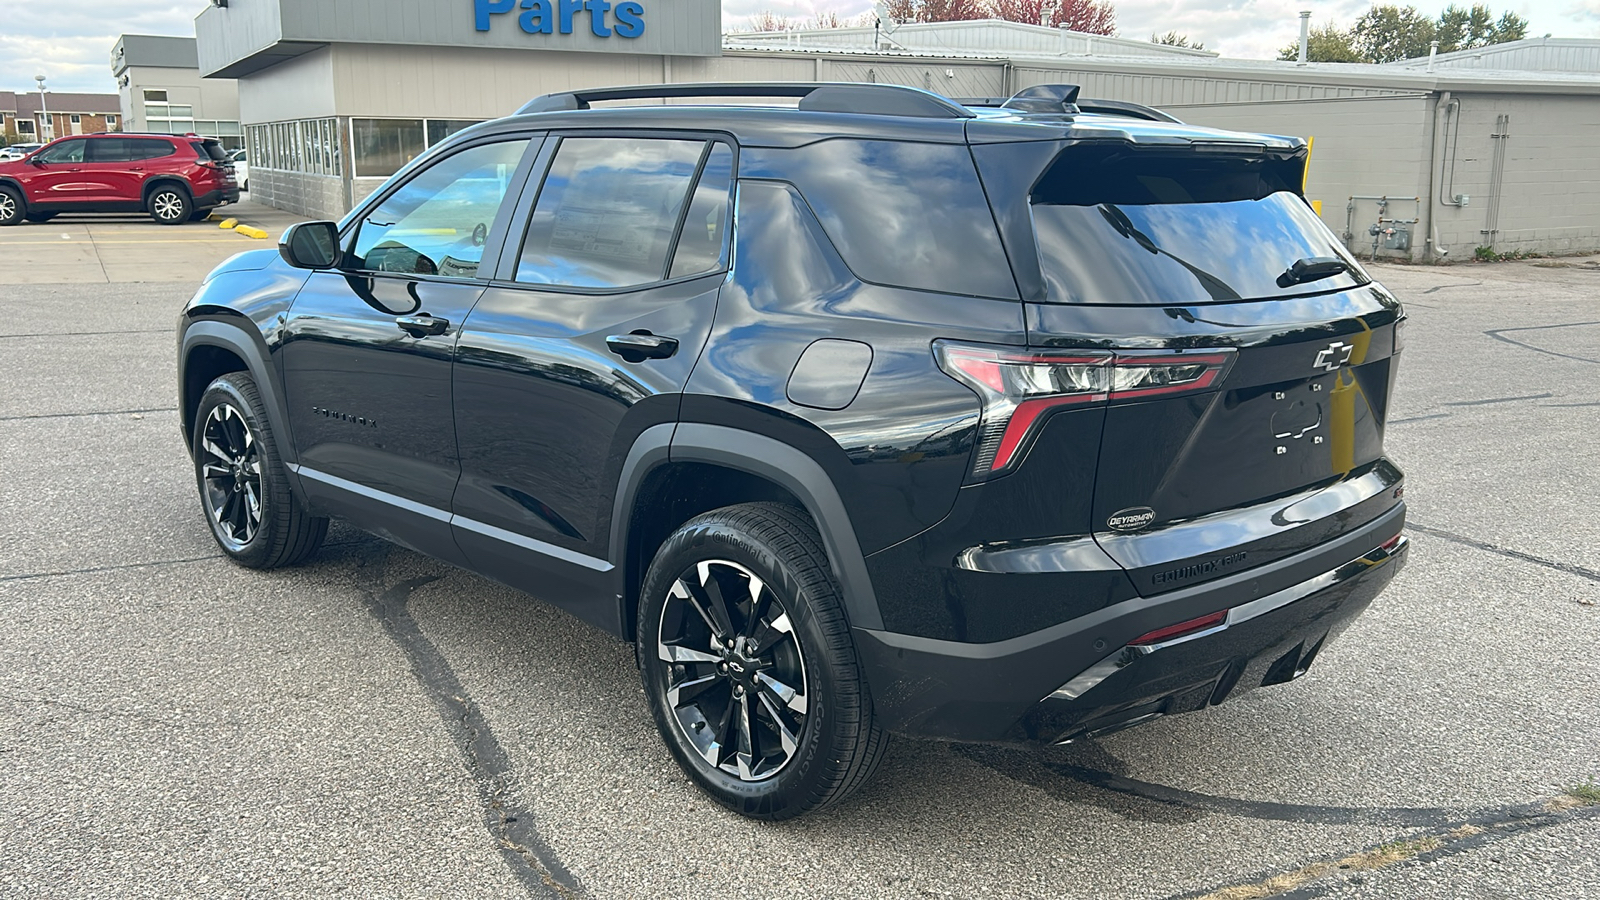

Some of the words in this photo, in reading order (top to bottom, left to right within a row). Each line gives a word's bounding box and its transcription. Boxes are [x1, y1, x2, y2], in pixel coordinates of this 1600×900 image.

[474, 0, 645, 38] Parts
[1109, 511, 1154, 526] DEYARMAN
[712, 530, 761, 560] Continental
[1151, 559, 1221, 585] EQUINOX
[798, 652, 825, 781] ROSSCONTACT
